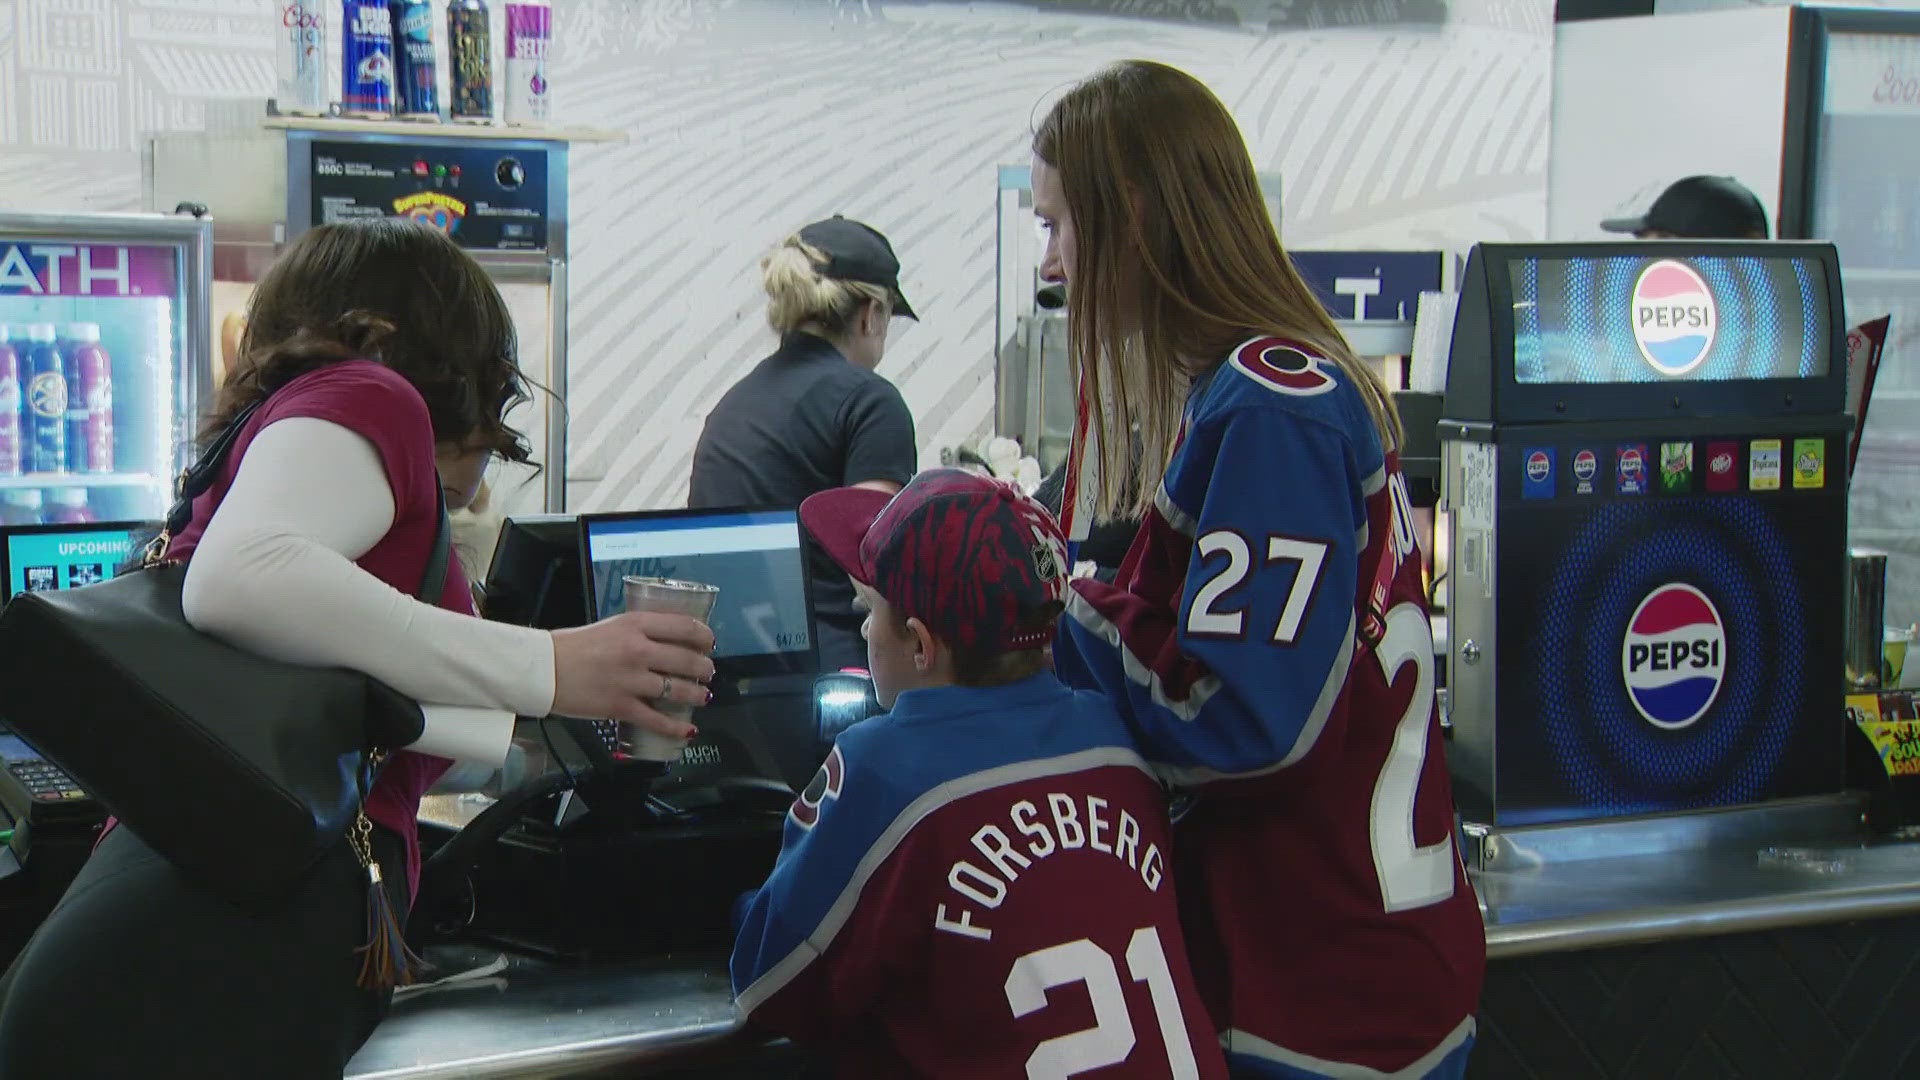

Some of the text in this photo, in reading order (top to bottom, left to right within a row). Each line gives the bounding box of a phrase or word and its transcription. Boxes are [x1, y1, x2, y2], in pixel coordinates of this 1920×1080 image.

[352, 19, 391, 36] LIGH
[1640, 305, 1708, 328] PEPSI
[1528, 462, 1548, 472] PEPSI
[1187, 531, 1328, 643] 27
[776, 633, 807, 649] $47.02
[1630, 639, 1718, 672] PEPSI
[683, 745, 720, 759] OUCH
[935, 793, 1164, 941] FORSBERG
[1004, 926, 1200, 1080] 21
